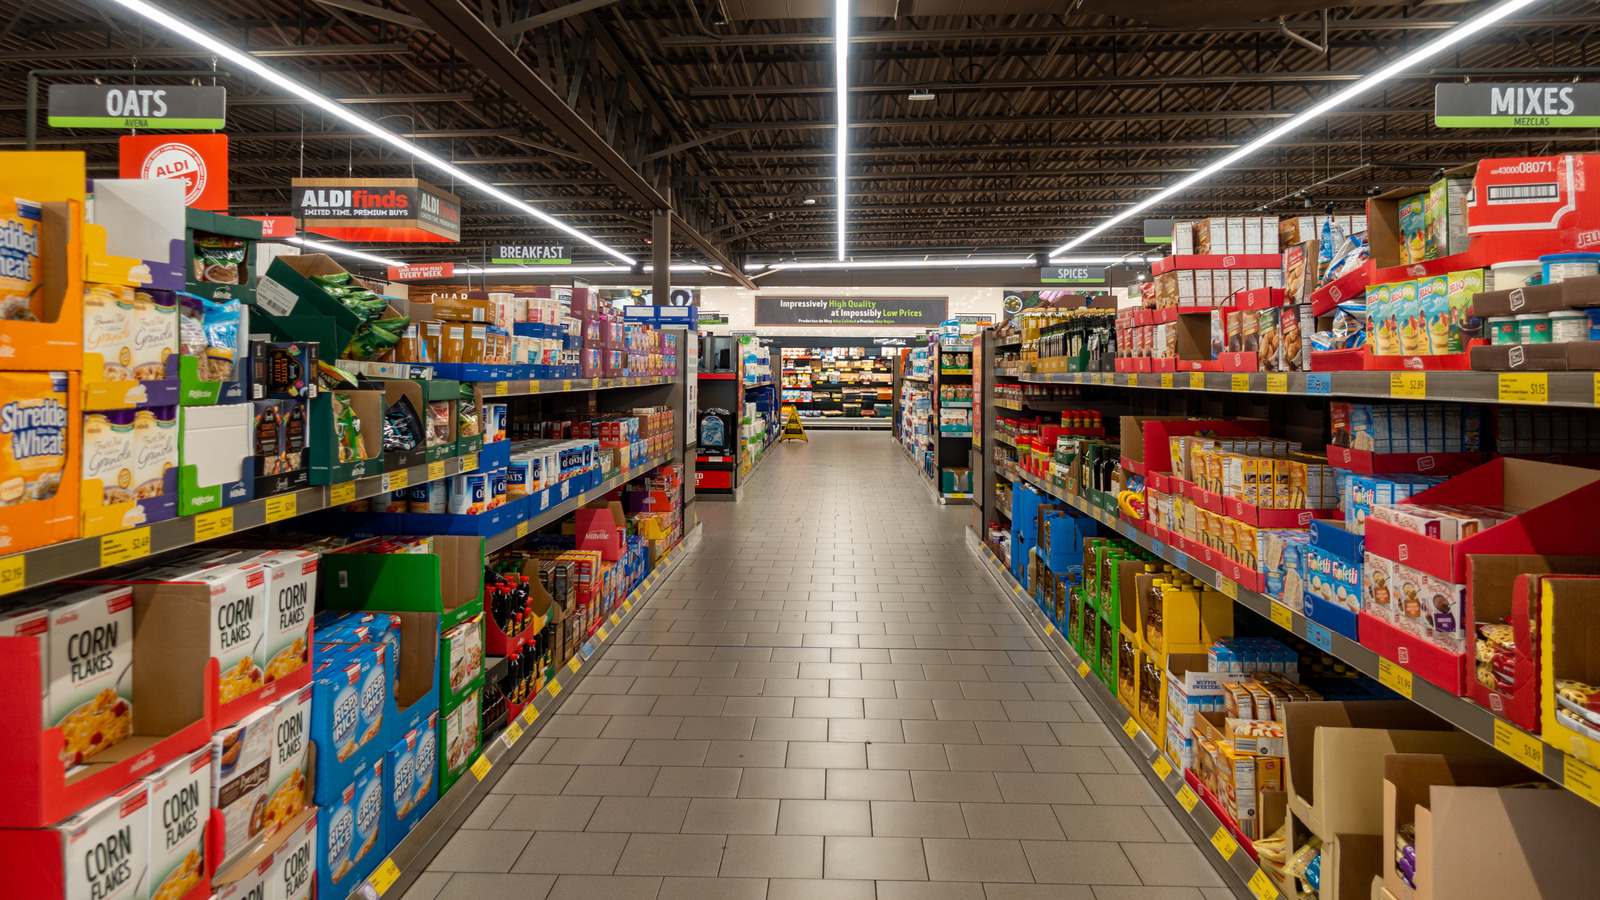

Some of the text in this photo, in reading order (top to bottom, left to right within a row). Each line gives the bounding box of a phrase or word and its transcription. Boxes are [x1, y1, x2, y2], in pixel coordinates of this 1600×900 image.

[106, 89, 168, 117] OATS
[1491, 87, 1575, 116] MIXES
[124, 119, 148, 127] AVENA
[1514, 117, 1550, 126] MEZCLAS
[156, 159, 189, 177] ALDI
[332, 209, 352, 217] TIME,
[500, 246, 564, 259] BREAKFAST
[1578, 231, 1600, 248] JELL
[399, 271, 422, 279] EVERY
[1058, 268, 1088, 279] SPICES
[780, 300, 876, 309] Impressively High Quality
[831, 309, 922, 318] at Impossibly Low Prices
[134, 321, 173, 350] Granola
[1530, 383, 1546, 395] $1.15
[12, 429, 64, 460] Wheat
[88, 440, 131, 476] Granola
[138, 435, 173, 469] Granola
[413, 489, 425, 499] ATS
[1353, 485, 1375, 505] Funfetti
[584, 531, 609, 541] Millville
[1307, 552, 1331, 575] Funfetti
[1332, 561, 1358, 586] Funfetti
[278, 581, 307, 612] CORN
[218, 594, 254, 631] CORN
[279, 606, 305, 630] FLAKES
[67, 620, 118, 662] CORN
[220, 622, 251, 650] FLAKES
[71, 650, 113, 683] FLAKES
[1397, 675, 1411, 690] $1.99
[334, 690, 359, 729] RISPY
[277, 710, 303, 748] CORN
[336, 709, 356, 741] RICE
[279, 736, 301, 765] FLAKES
[420, 750, 435, 777] RICE
[1523, 744, 1541, 761] $1.89
[395, 757, 413, 788] RISPY
[396, 771, 412, 798] RICE
[163, 780, 199, 829] CORN
[363, 800, 380, 830] RICE
[166, 811, 198, 850] FLAKES
[329, 808, 353, 849] RISPY
[85, 824, 132, 882] CORN
[330, 828, 351, 862] RICE
[284, 839, 310, 883] CORN
[91, 859, 131, 900] FLAKES
[286, 865, 309, 899] FLAKES
